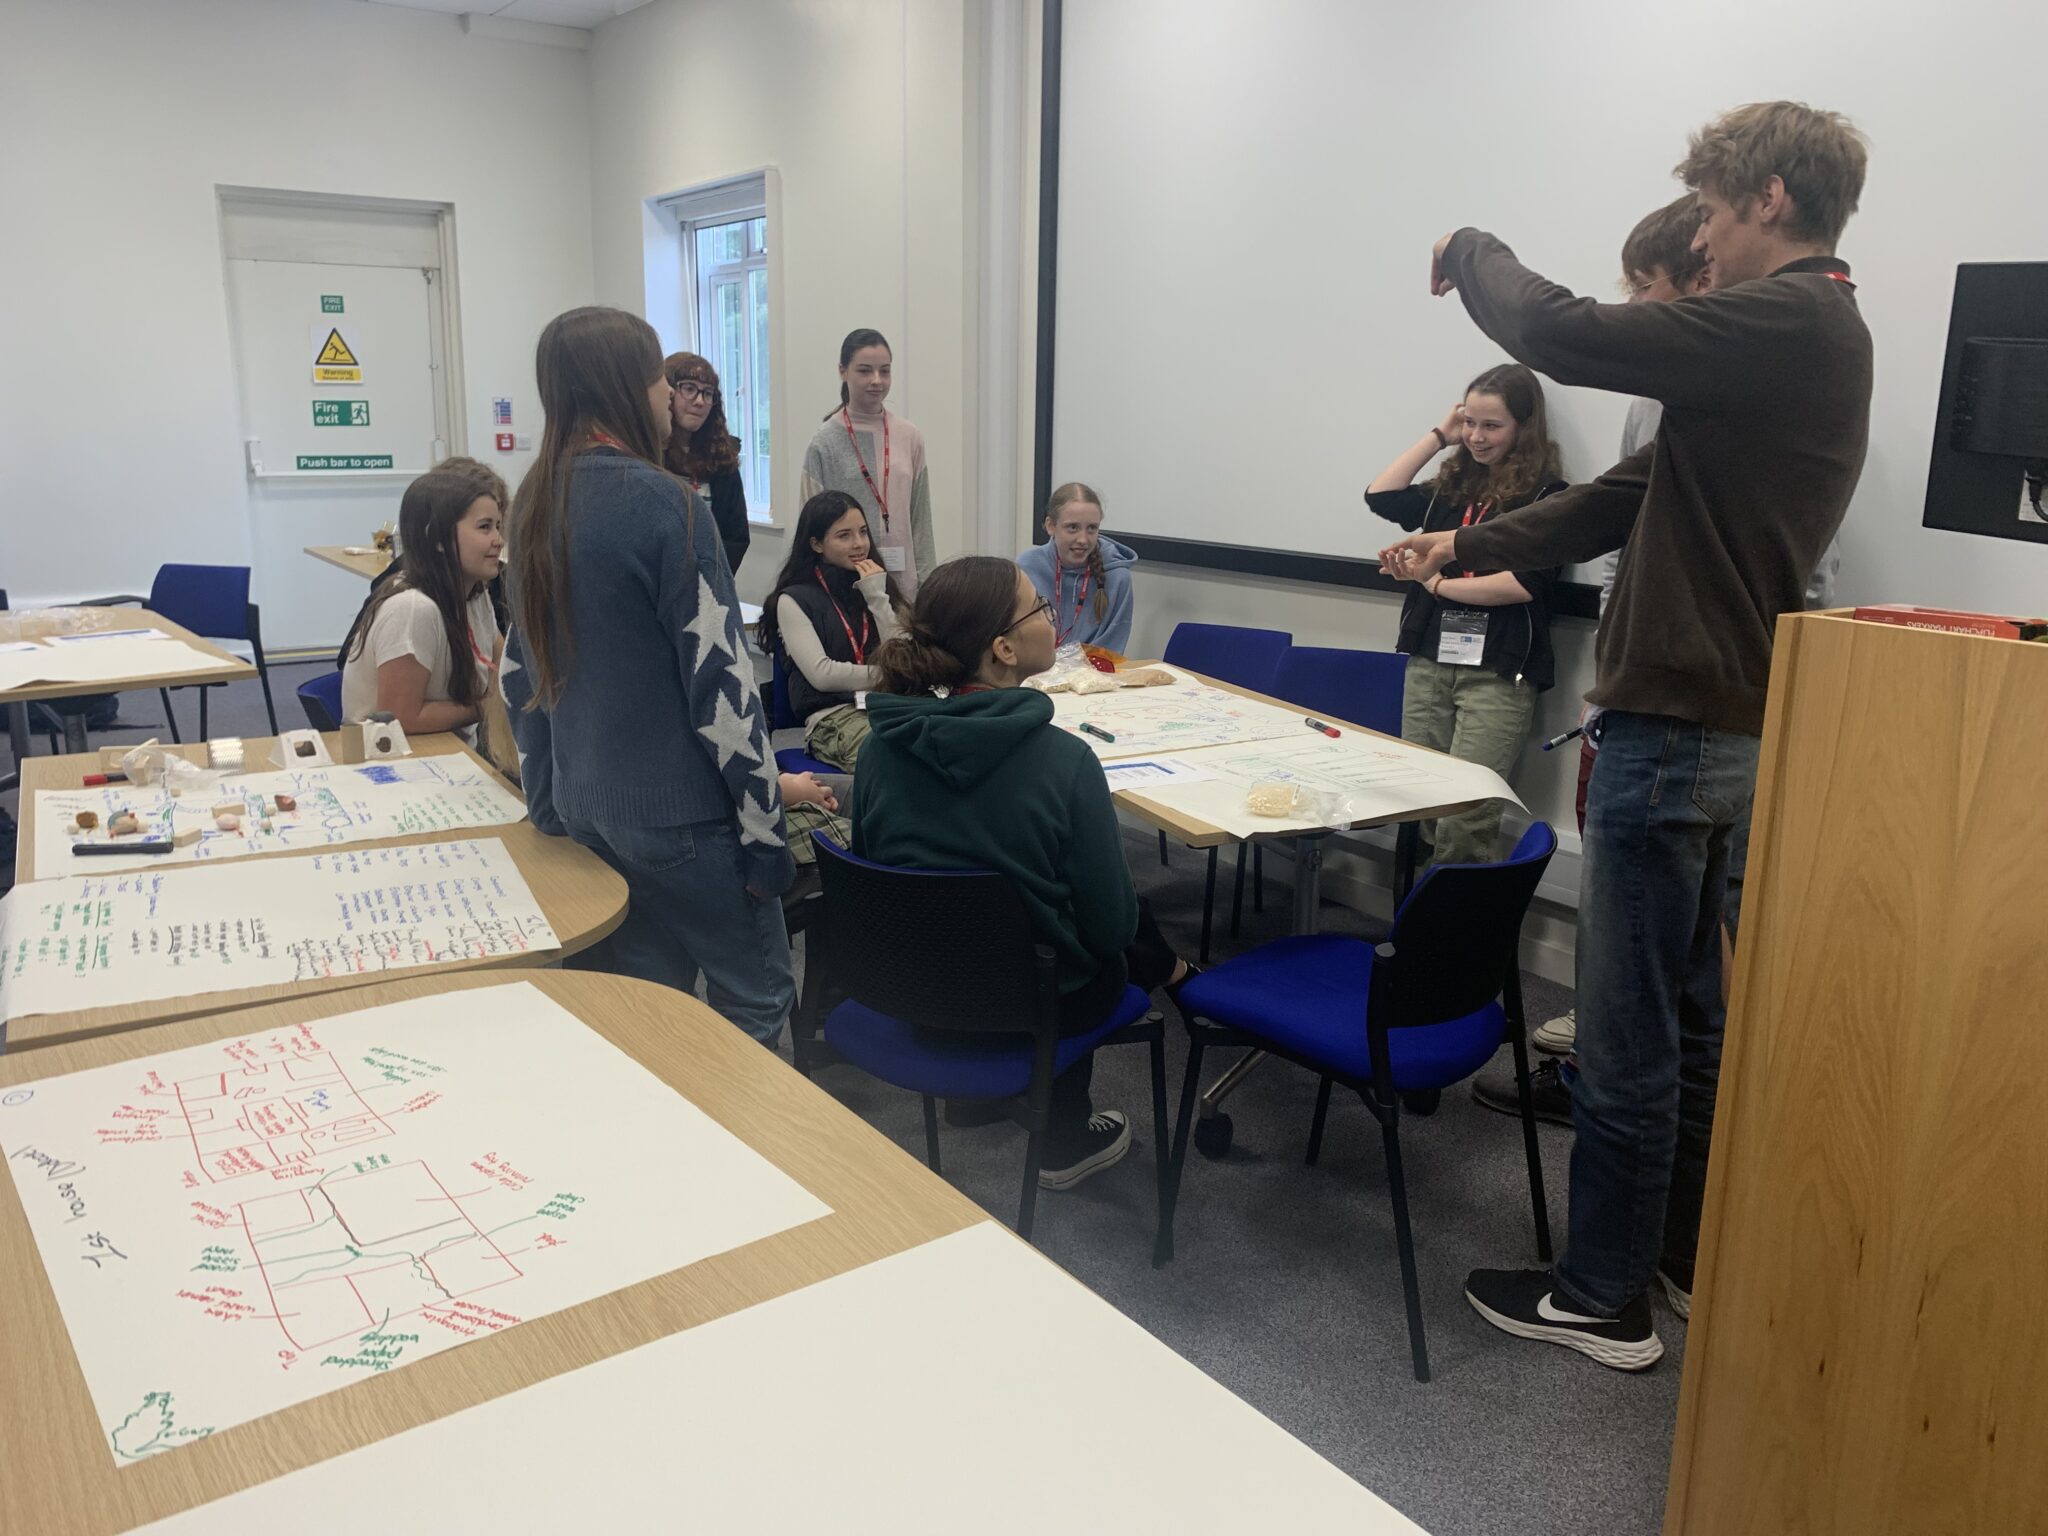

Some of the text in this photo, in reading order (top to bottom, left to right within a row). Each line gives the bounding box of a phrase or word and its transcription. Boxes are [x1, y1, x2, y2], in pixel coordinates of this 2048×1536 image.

[324, 304, 342, 312] EXIT
[322, 368, 354, 377] Warning
[314, 402, 339, 413] Fire
[316, 413, 340, 424] exit
[300, 458, 390, 469] Push bar to open
[58, 1182, 87, 1223] house
